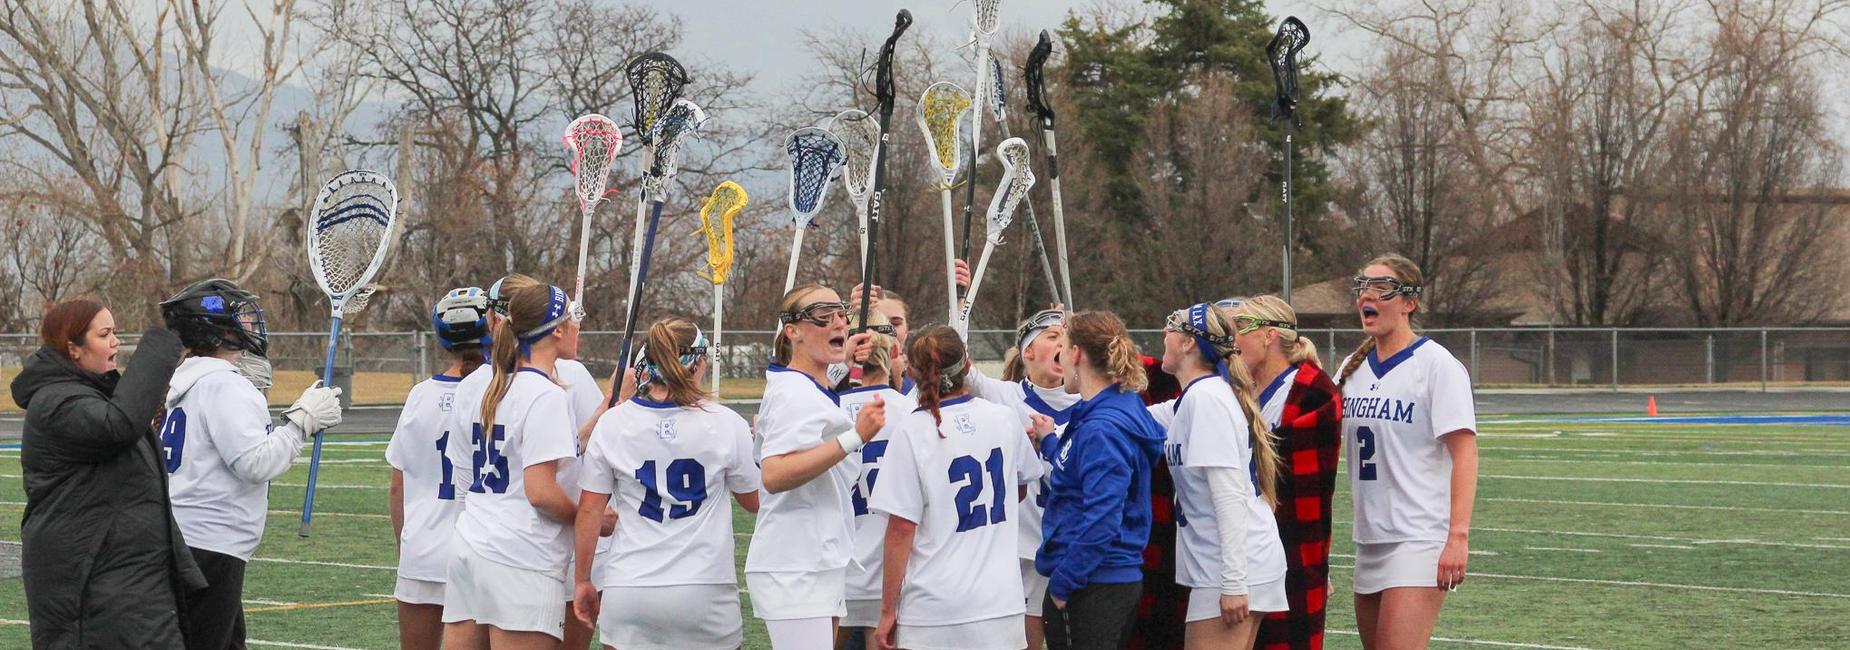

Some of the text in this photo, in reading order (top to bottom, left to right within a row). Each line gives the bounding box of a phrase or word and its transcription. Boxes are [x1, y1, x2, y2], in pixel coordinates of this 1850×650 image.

[872, 191, 881, 222] GAIT
[960, 301, 971, 321] GAIT
[1192, 310, 1203, 326] LAX
[160, 407, 187, 474] 9
[1356, 426, 1378, 481] 2
[635, 458, 708, 524] 19
[948, 447, 1006, 533] 21
